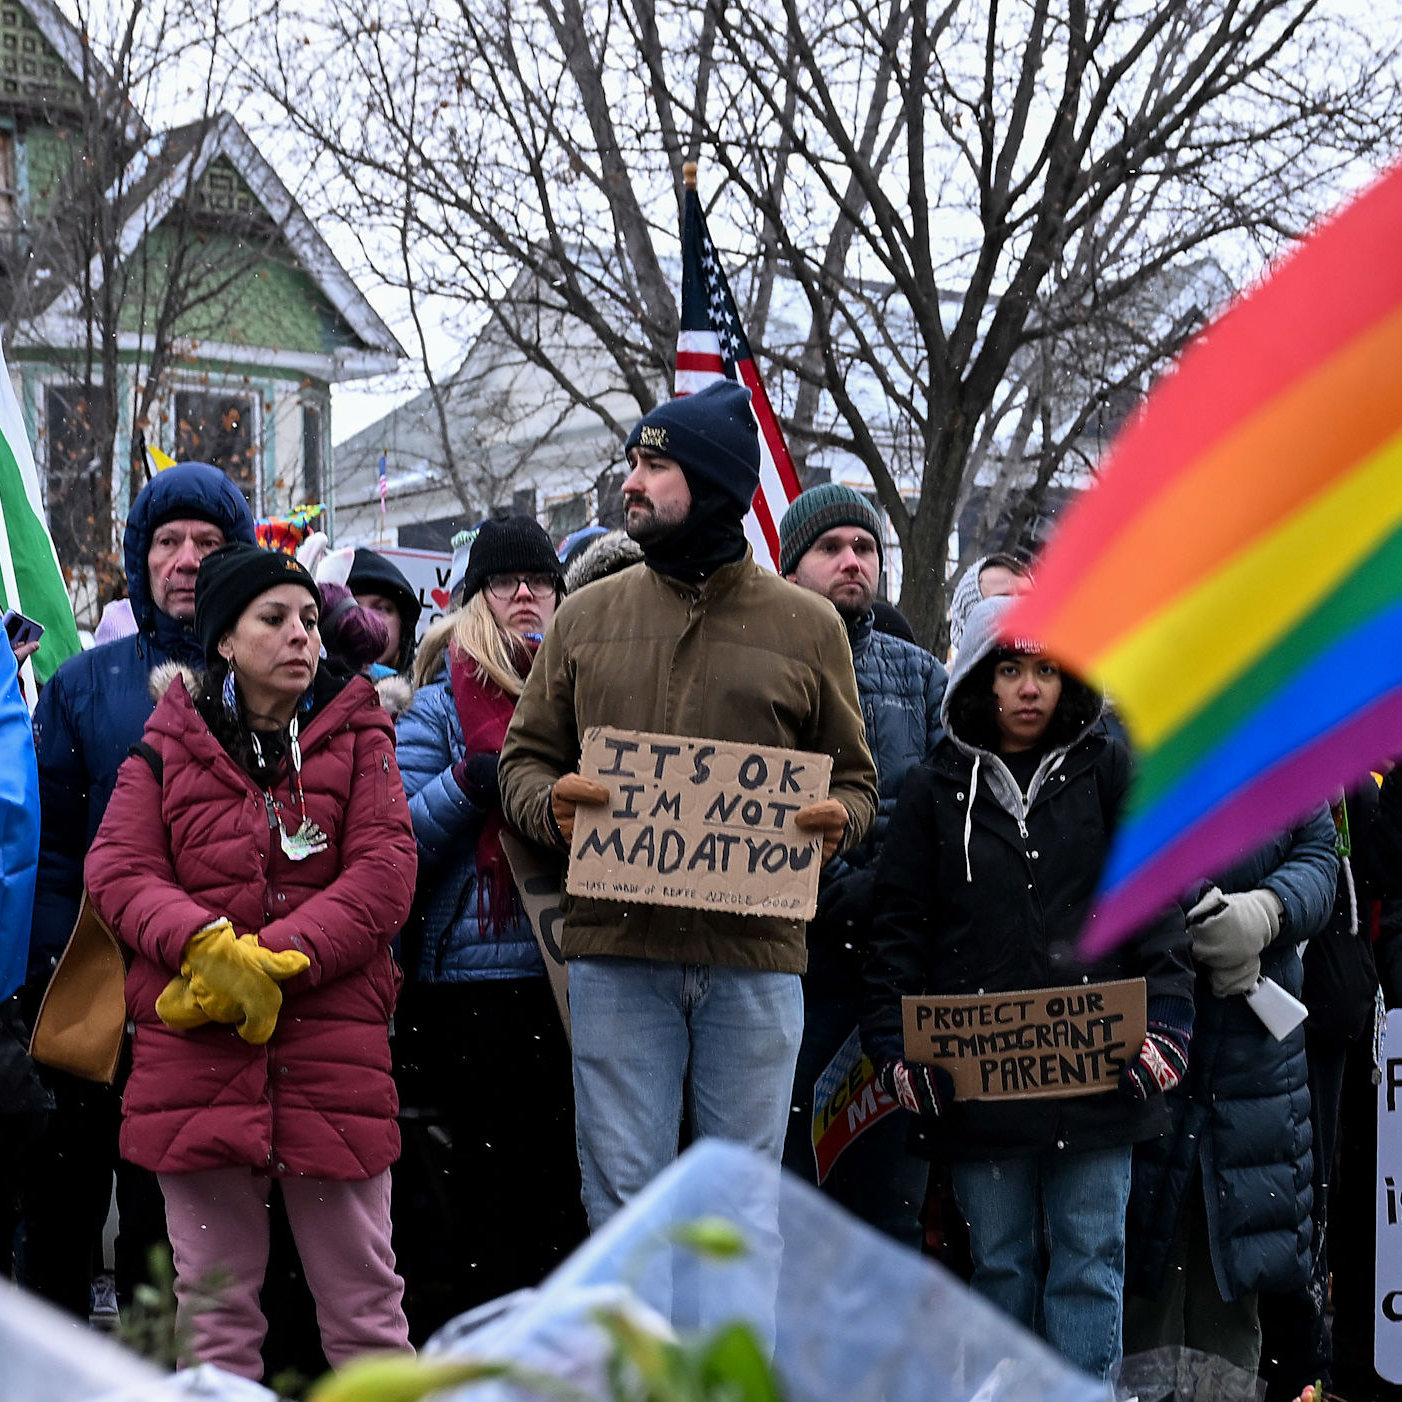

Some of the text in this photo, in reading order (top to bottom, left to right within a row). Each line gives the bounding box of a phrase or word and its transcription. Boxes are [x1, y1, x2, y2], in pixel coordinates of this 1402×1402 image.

[612, 784, 801, 829] I'M NOT
[577, 825, 686, 875] MAD
[687, 833, 740, 872] AT
[916, 992, 1104, 1031] PROTECT OUR
[930, 1013, 1124, 1058] IMMIGRANT
[980, 1042, 1126, 1093] PARENTS
